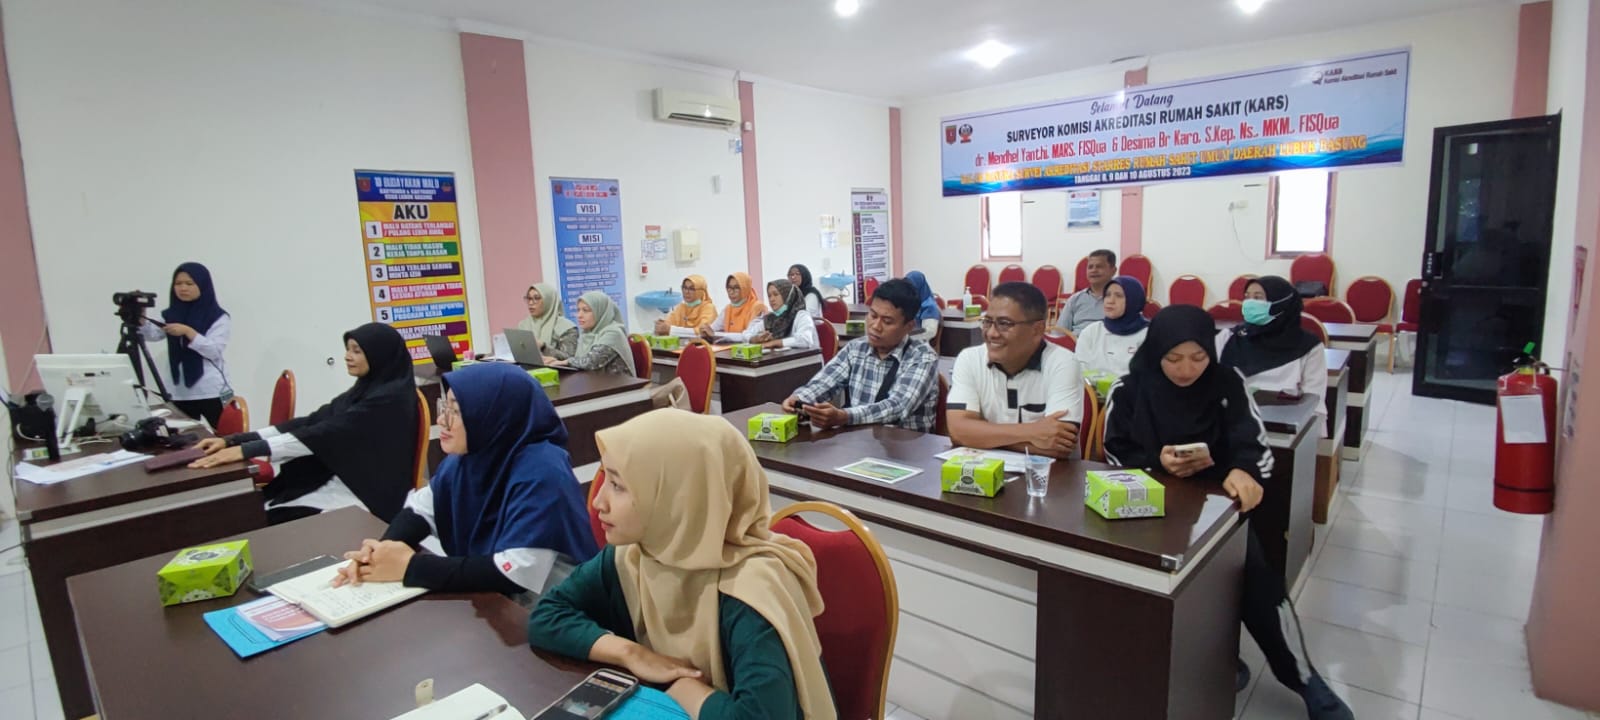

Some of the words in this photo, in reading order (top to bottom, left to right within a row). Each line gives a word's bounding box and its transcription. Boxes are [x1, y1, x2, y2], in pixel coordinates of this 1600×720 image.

[1133, 94, 1174, 109] Datang
[1007, 126, 1055, 143] SURVEYOR
[1058, 120, 1092, 137] KOMISI
[1094, 111, 1157, 132] AKREDITASI
[1160, 106, 1202, 124] RUMAH
[1206, 101, 1241, 118] SAKIT
[1244, 94, 1289, 117] (KARS)
[988, 148, 1019, 165] Mendhel
[1079, 139, 1107, 157] FISQua
[1112, 137, 1118, 152] &
[1121, 134, 1156, 151] Desima
[1159, 131, 1170, 148] Br
[1299, 112, 1340, 134] FISQua
[1044, 161, 1090, 176] AKREDITASI
[1133, 154, 1166, 168] RUMAH
[1168, 151, 1197, 165] SAKIT
[1200, 148, 1230, 163] UMUM
[1233, 143, 1276, 160] DAERAH
[1279, 140, 1316, 156] LUBUK
[1319, 135, 1367, 153] BASUNG
[1115, 171, 1129, 181] DAN
[1139, 168, 1171, 179] AGUSTUS
[1172, 166, 1191, 177] 2023
[422, 178, 440, 189] MALU
[394, 205, 428, 220] AKU
[580, 205, 597, 213] VISI
[371, 225, 377, 235] 1
[582, 234, 600, 242] MISI
[373, 246, 380, 257] 2
[376, 268, 383, 278] 3
[379, 289, 386, 299] 4
[381, 310, 388, 320] 5
[394, 312, 424, 320] PROGRAM
[425, 310, 443, 318] KERJA
